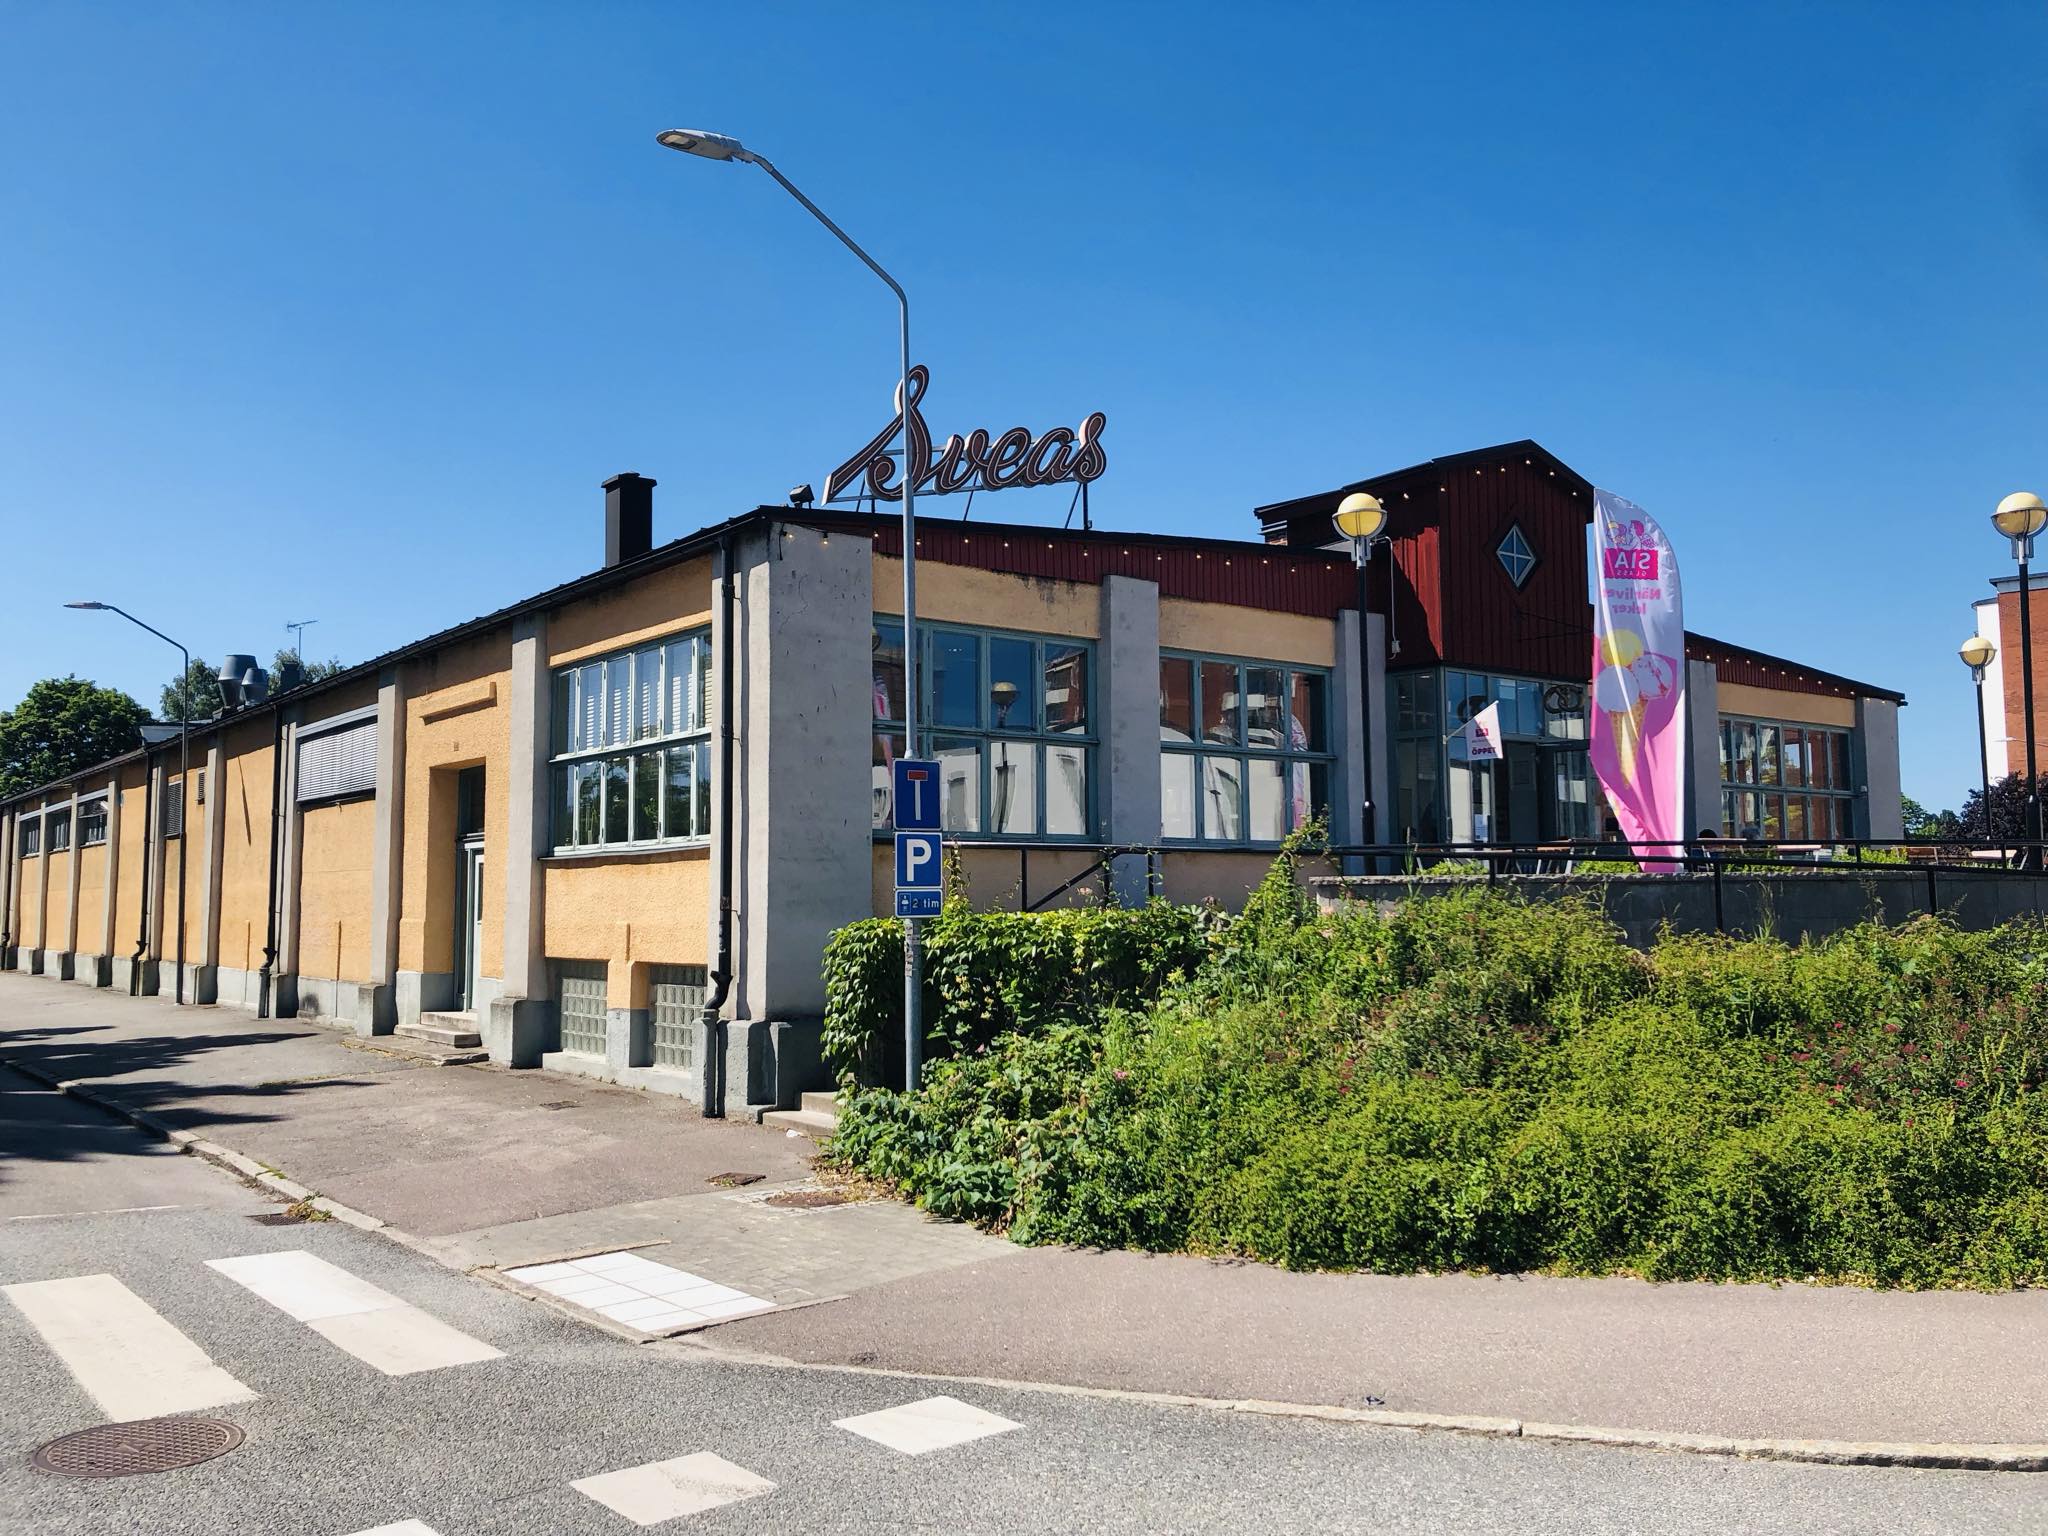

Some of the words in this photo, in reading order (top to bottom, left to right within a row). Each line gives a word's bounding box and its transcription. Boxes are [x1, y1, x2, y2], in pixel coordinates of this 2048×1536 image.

[821, 364, 1107, 506] Sveas
[1472, 746, 1496, 755] ÖPPET
[906, 838, 932, 882] P
[923, 897, 940, 908] tim
